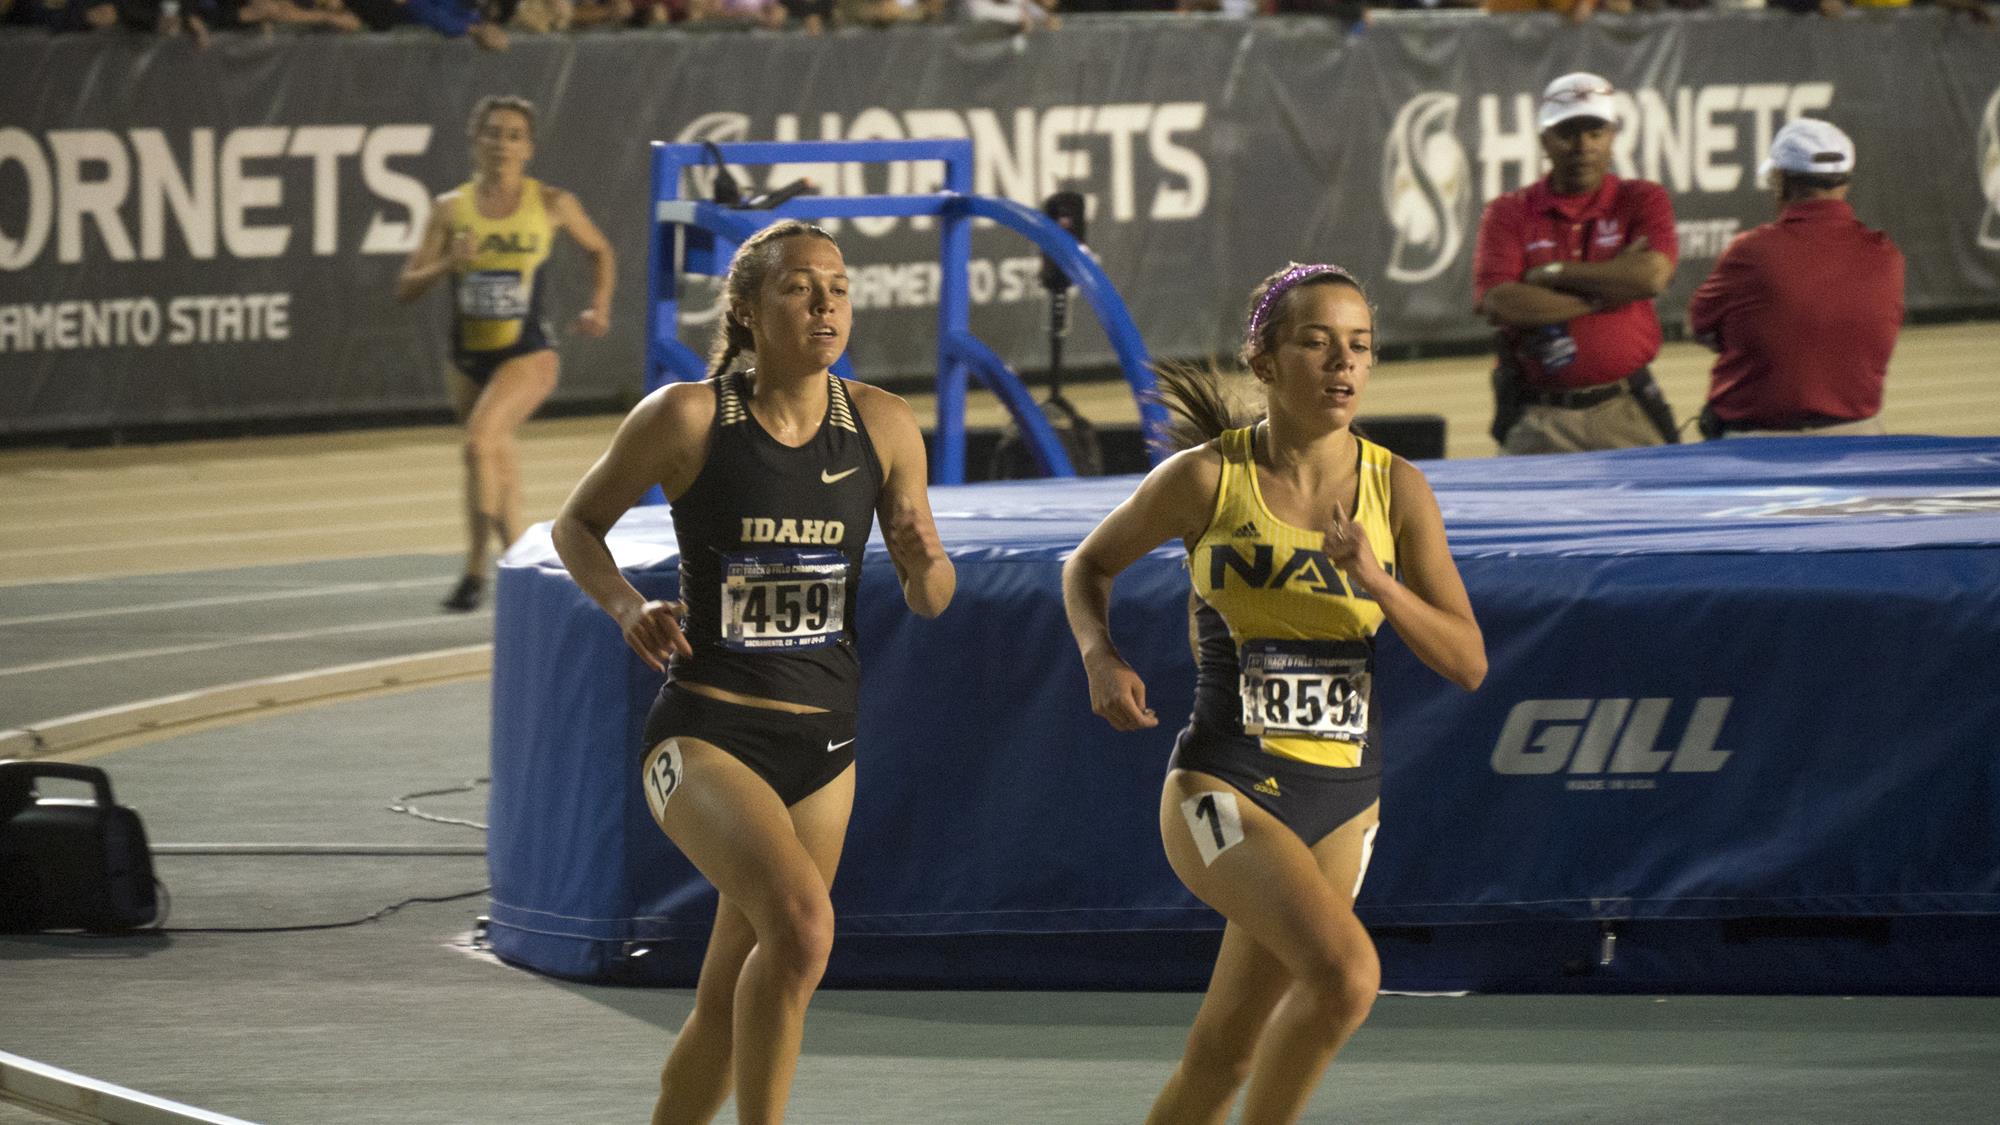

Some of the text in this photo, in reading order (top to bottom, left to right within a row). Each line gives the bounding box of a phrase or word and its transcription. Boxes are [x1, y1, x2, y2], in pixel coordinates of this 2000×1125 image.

[1479, 82, 1834, 200] HRNET
[168, 293, 291, 345] STATE
[741, 518, 845, 544] IDAHO
[742, 583, 829, 633] 459
[1263, 678, 1354, 726] 859
[1490, 697, 1734, 775] GILL
[651, 751, 677, 805] 13
[1195, 793, 1226, 850] 1
